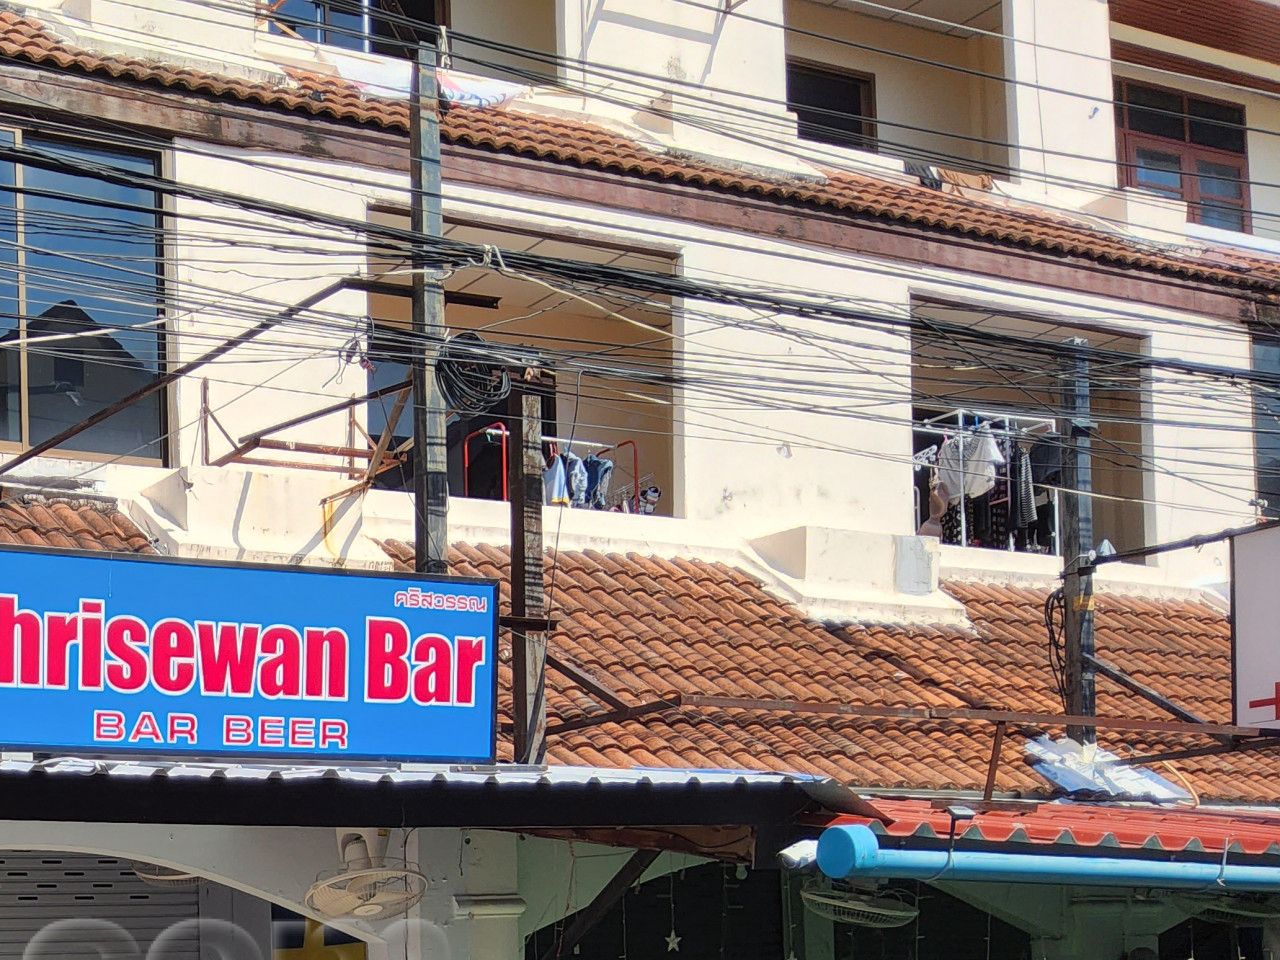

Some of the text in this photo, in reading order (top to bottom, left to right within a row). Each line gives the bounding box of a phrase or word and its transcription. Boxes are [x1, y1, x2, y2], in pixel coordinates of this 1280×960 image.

[364, 616, 486, 708] Bar
[93, 709, 349, 749] BAR BEER
